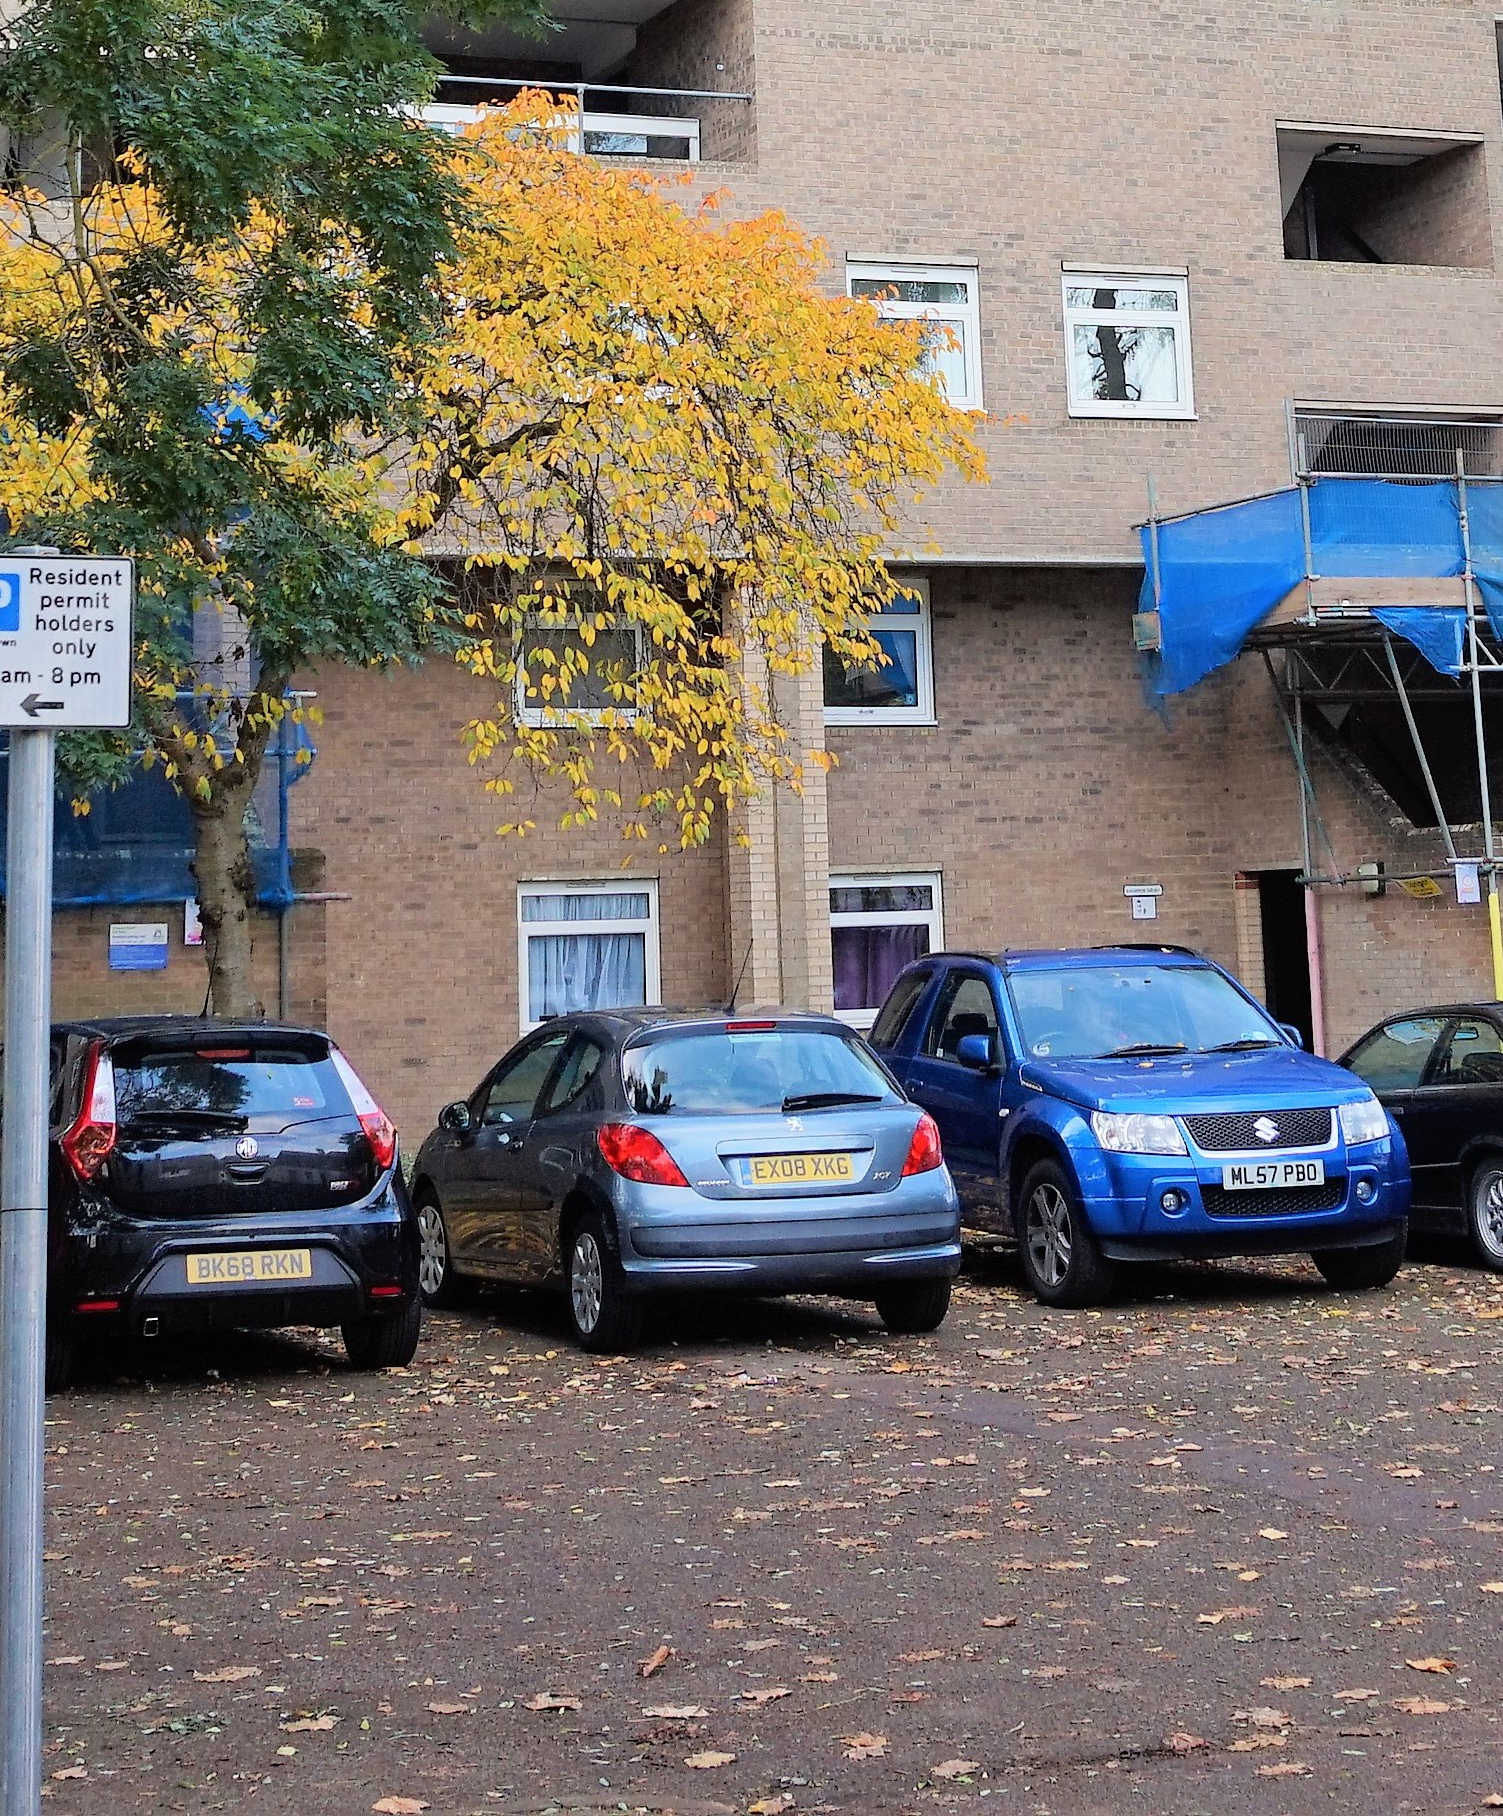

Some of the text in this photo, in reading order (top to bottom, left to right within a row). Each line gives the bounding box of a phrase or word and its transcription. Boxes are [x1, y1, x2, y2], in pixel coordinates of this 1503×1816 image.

[29, 567, 123, 586] Resident
[40, 592, 110, 611] permit
[35, 614, 115, 633] holders
[52, 638, 97, 659] only
[1, 670, 32, 684] am
[51, 667, 64, 684] 8
[70, 670, 102, 687] pm
[753, 1157, 850, 1179] EX08 XKG
[1231, 1163, 1317, 1186] ML57 PBO
[197, 1253, 305, 1279] BK68 RKN
